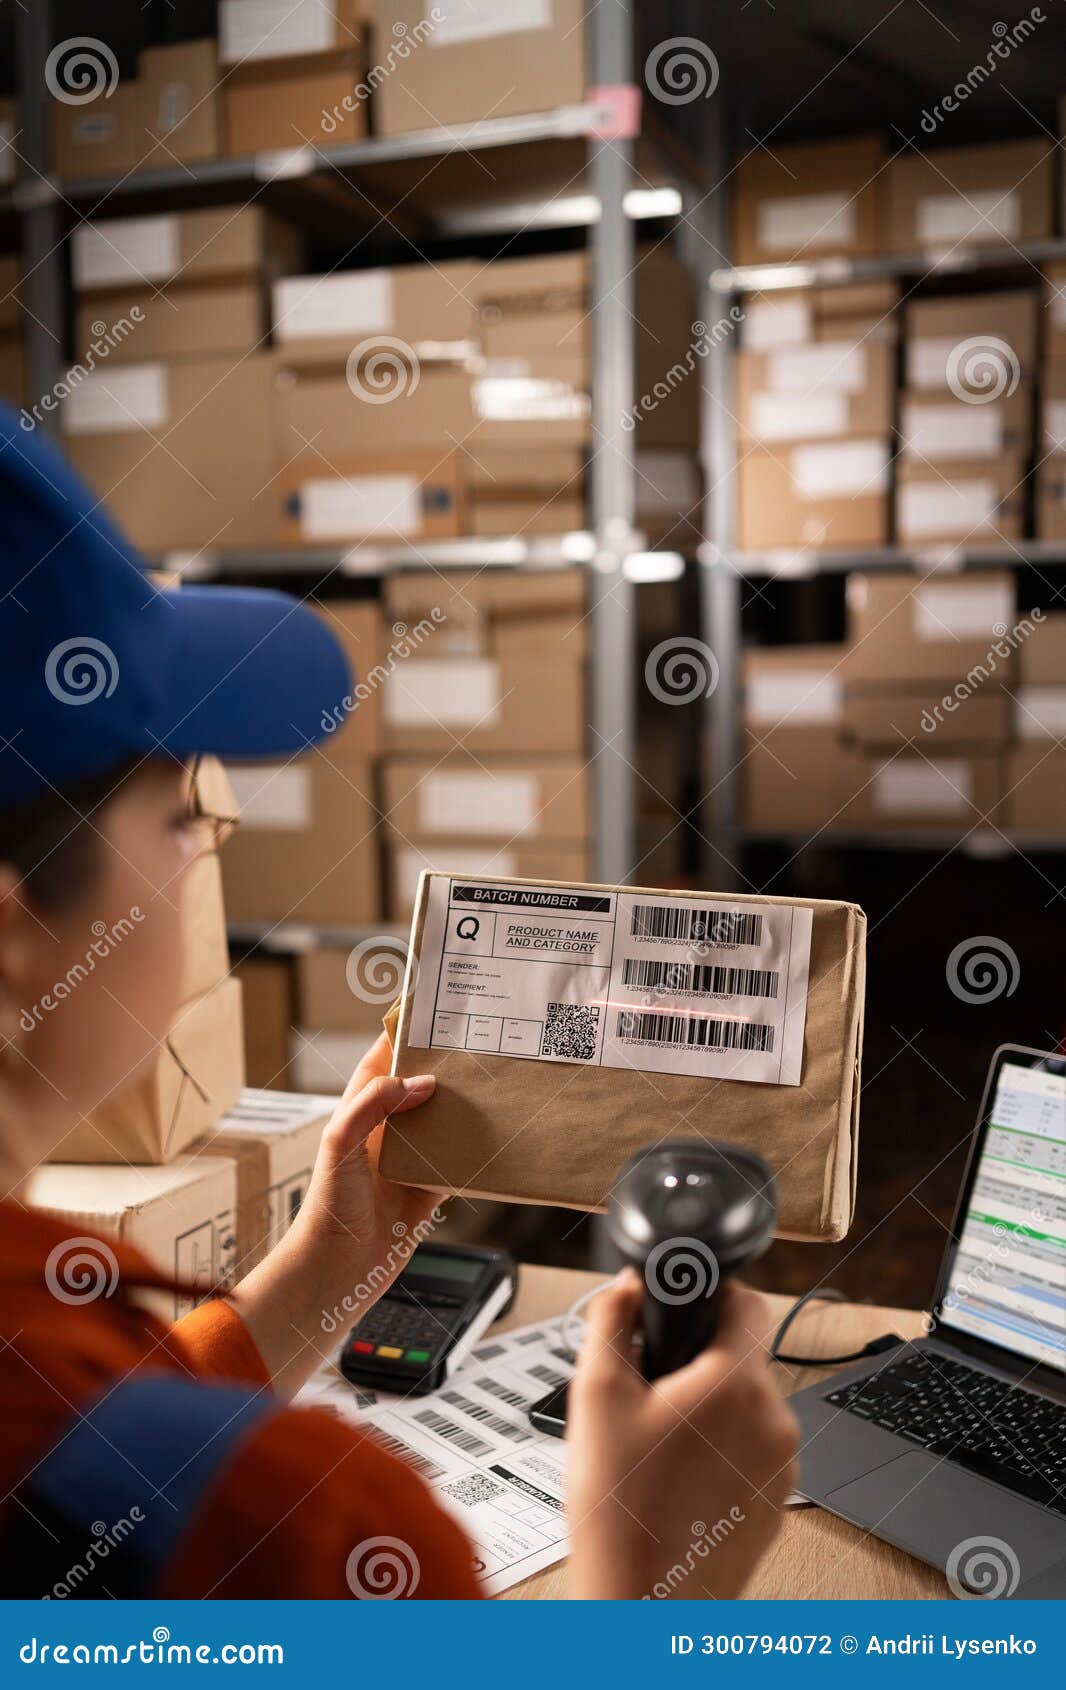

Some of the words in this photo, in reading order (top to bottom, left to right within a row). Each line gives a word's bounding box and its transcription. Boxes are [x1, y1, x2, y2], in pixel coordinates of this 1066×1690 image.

[473, 889, 517, 903] BATCH
[520, 893, 578, 907] NUMBER
[456, 916, 480, 941] Q
[507, 925, 564, 939] PRODUCT
[566, 930, 599, 941] NAME
[506, 937, 531, 947] AND
[534, 939, 596, 952] CATEGORY
